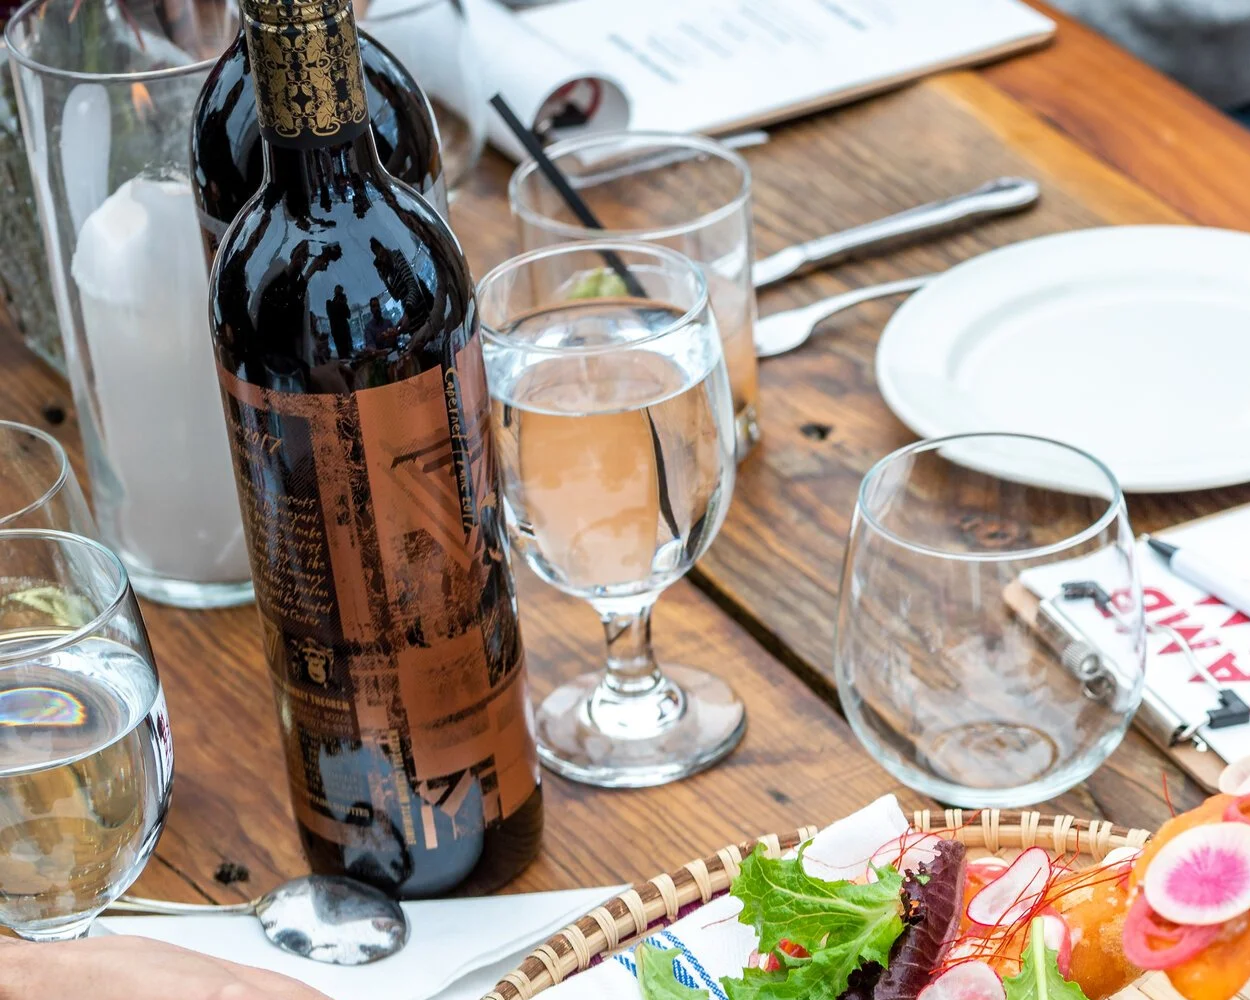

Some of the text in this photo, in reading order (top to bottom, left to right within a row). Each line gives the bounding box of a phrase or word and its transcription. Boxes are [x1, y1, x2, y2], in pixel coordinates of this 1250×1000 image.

[244, 427, 283, 456] 2017
[461, 496, 477, 528] 2017
[306, 557, 325, 570] the
